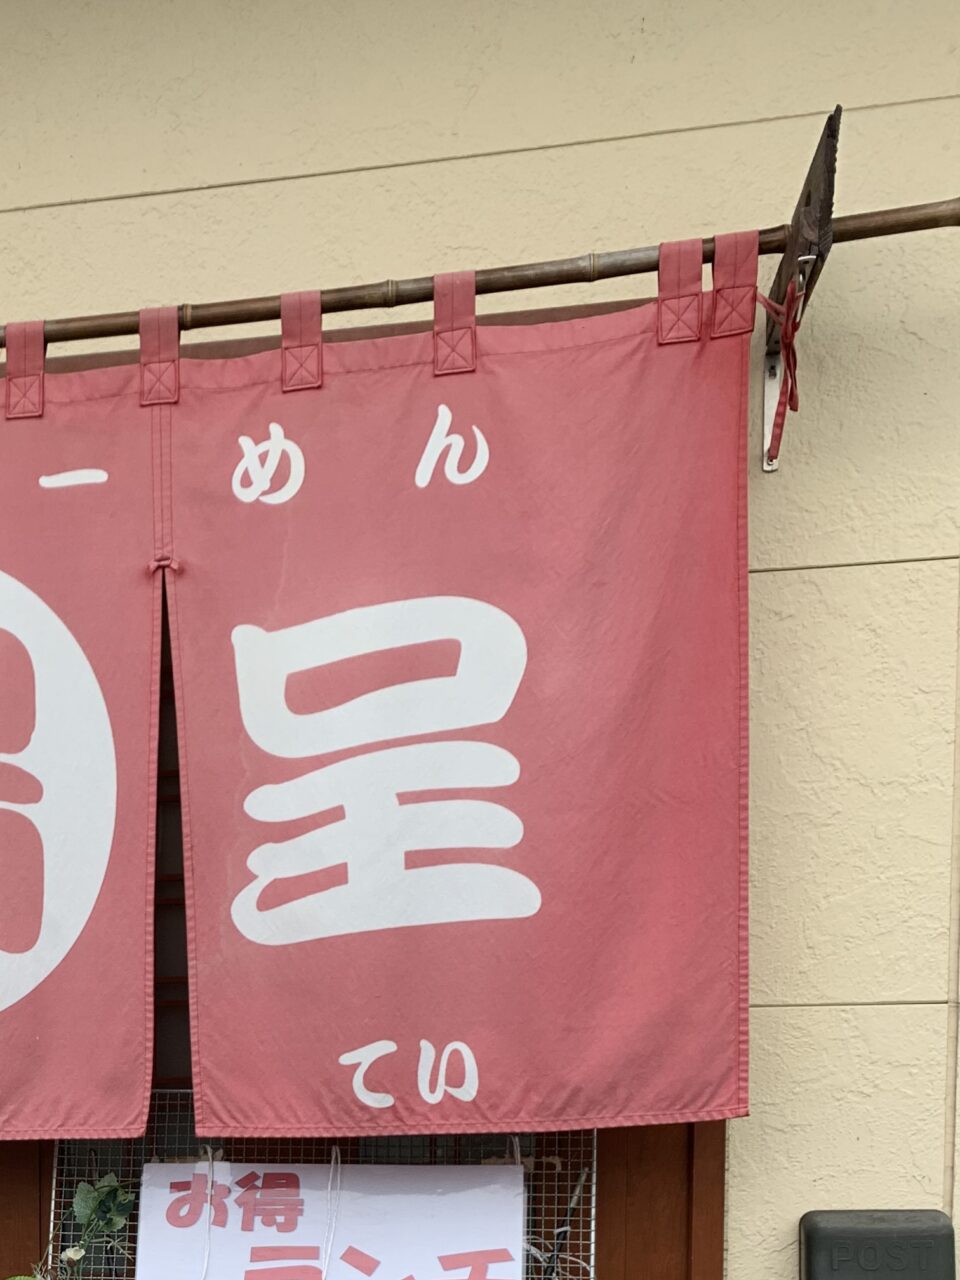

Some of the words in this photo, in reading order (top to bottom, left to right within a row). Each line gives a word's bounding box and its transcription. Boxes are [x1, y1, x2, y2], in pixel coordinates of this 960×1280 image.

[337, 1039, 479, 1109] てい
[165, 1171, 304, 1233] お得
[830, 1237, 935, 1272] POST
